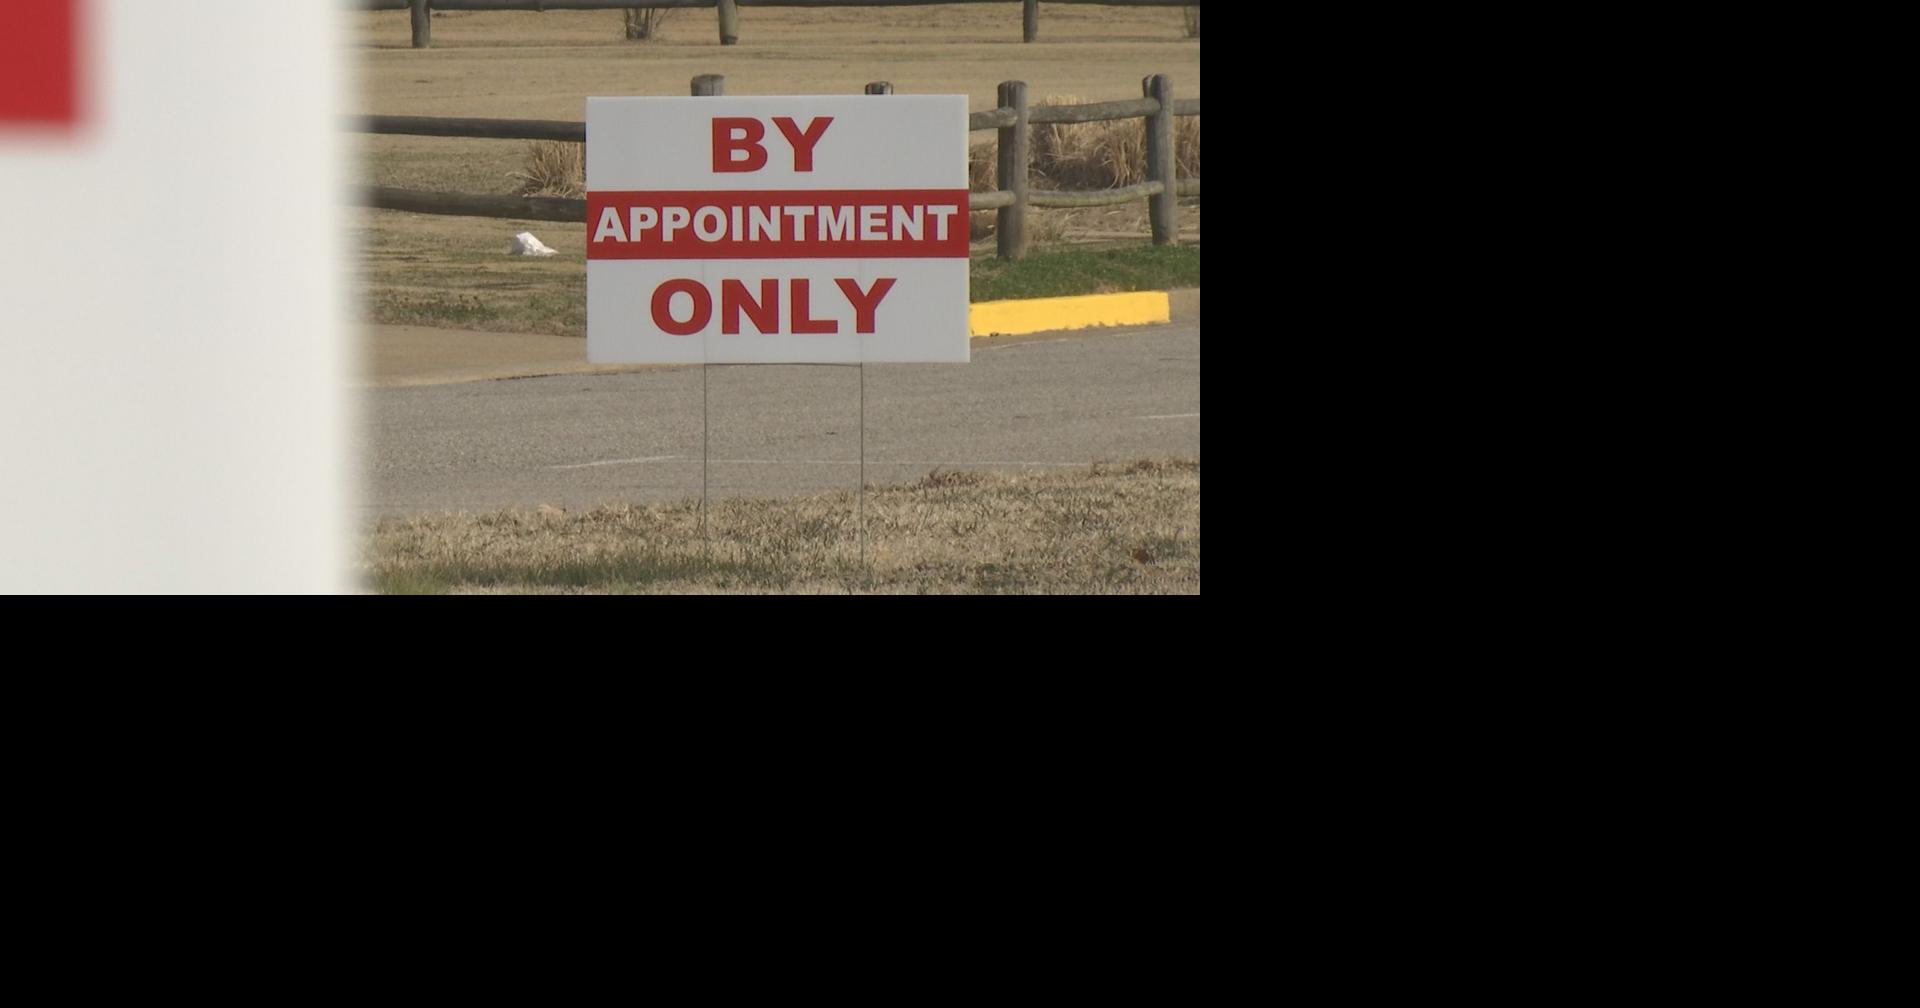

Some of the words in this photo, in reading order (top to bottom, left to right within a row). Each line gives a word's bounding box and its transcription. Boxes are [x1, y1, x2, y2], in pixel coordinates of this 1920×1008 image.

[711, 116, 835, 173] BY
[593, 204, 959, 243] APPOINTMENT
[650, 277, 898, 336] ONLY
